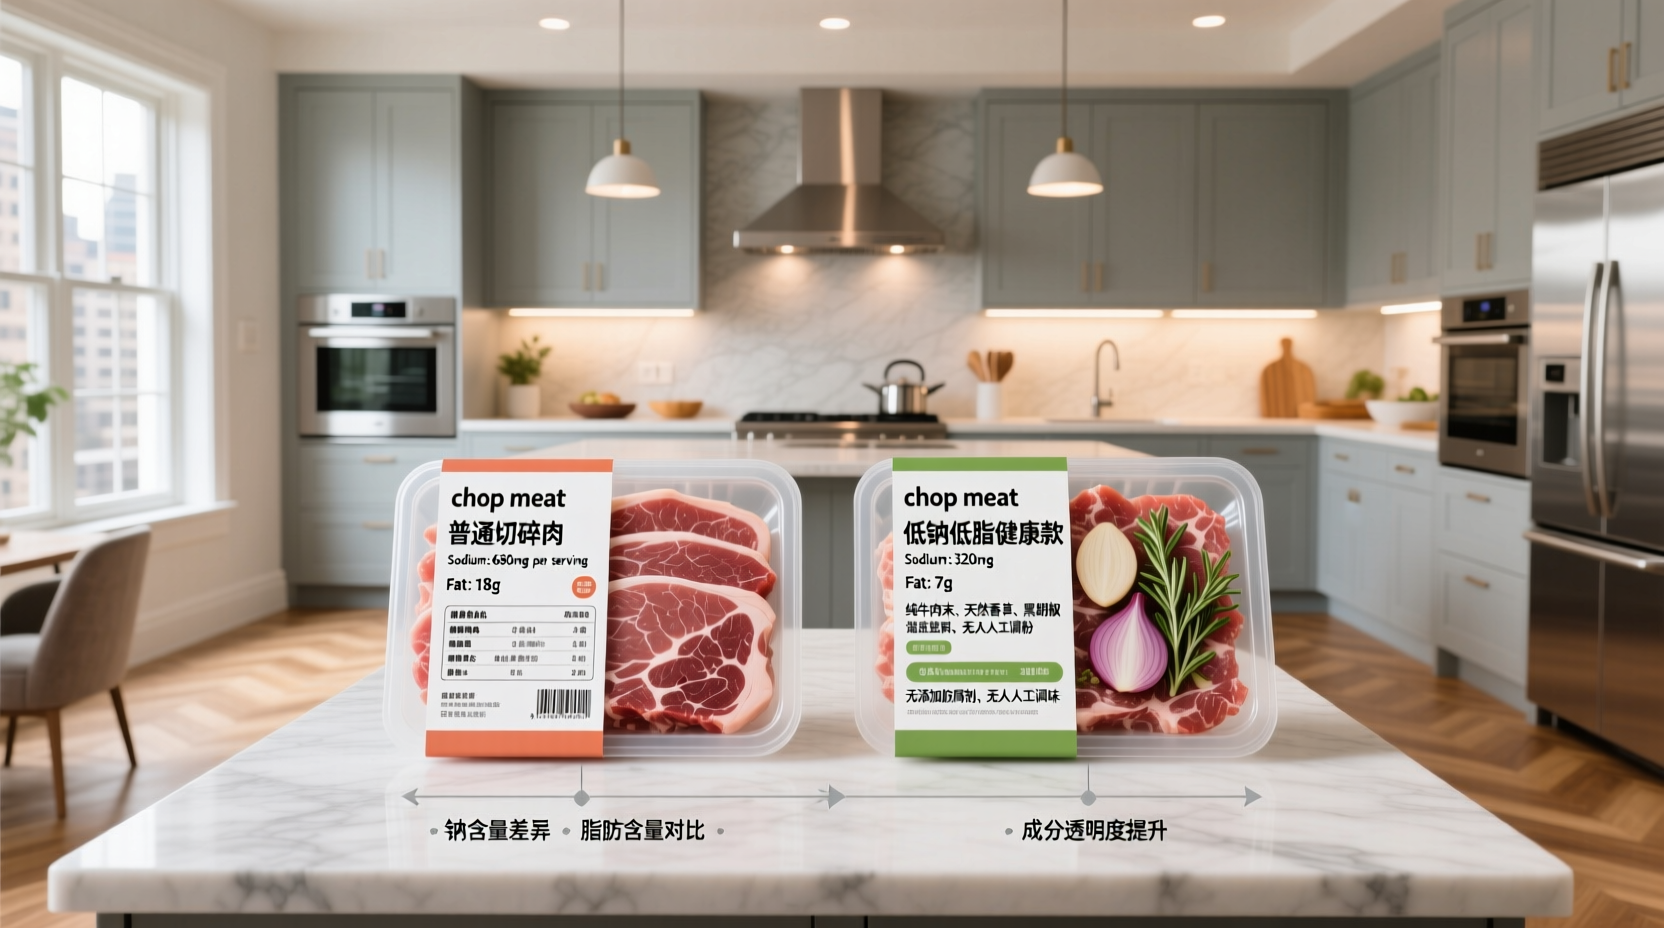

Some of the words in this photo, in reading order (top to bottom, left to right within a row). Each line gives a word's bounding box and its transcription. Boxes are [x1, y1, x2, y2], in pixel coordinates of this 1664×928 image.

[451, 486, 505, 513] chop
[510, 489, 567, 508] meat
[904, 486, 958, 512] chop
[963, 488, 1019, 507] meat
[449, 519, 564, 546] 普通切碎肉
[903, 519, 1064, 546] 低钠低脂健康款
[551, 554, 589, 569] serving
[446, 577, 472, 591] Fat:
[475, 577, 501, 595] 18g
[905, 575, 931, 590] Fat:
[934, 575, 953, 593] 7g
